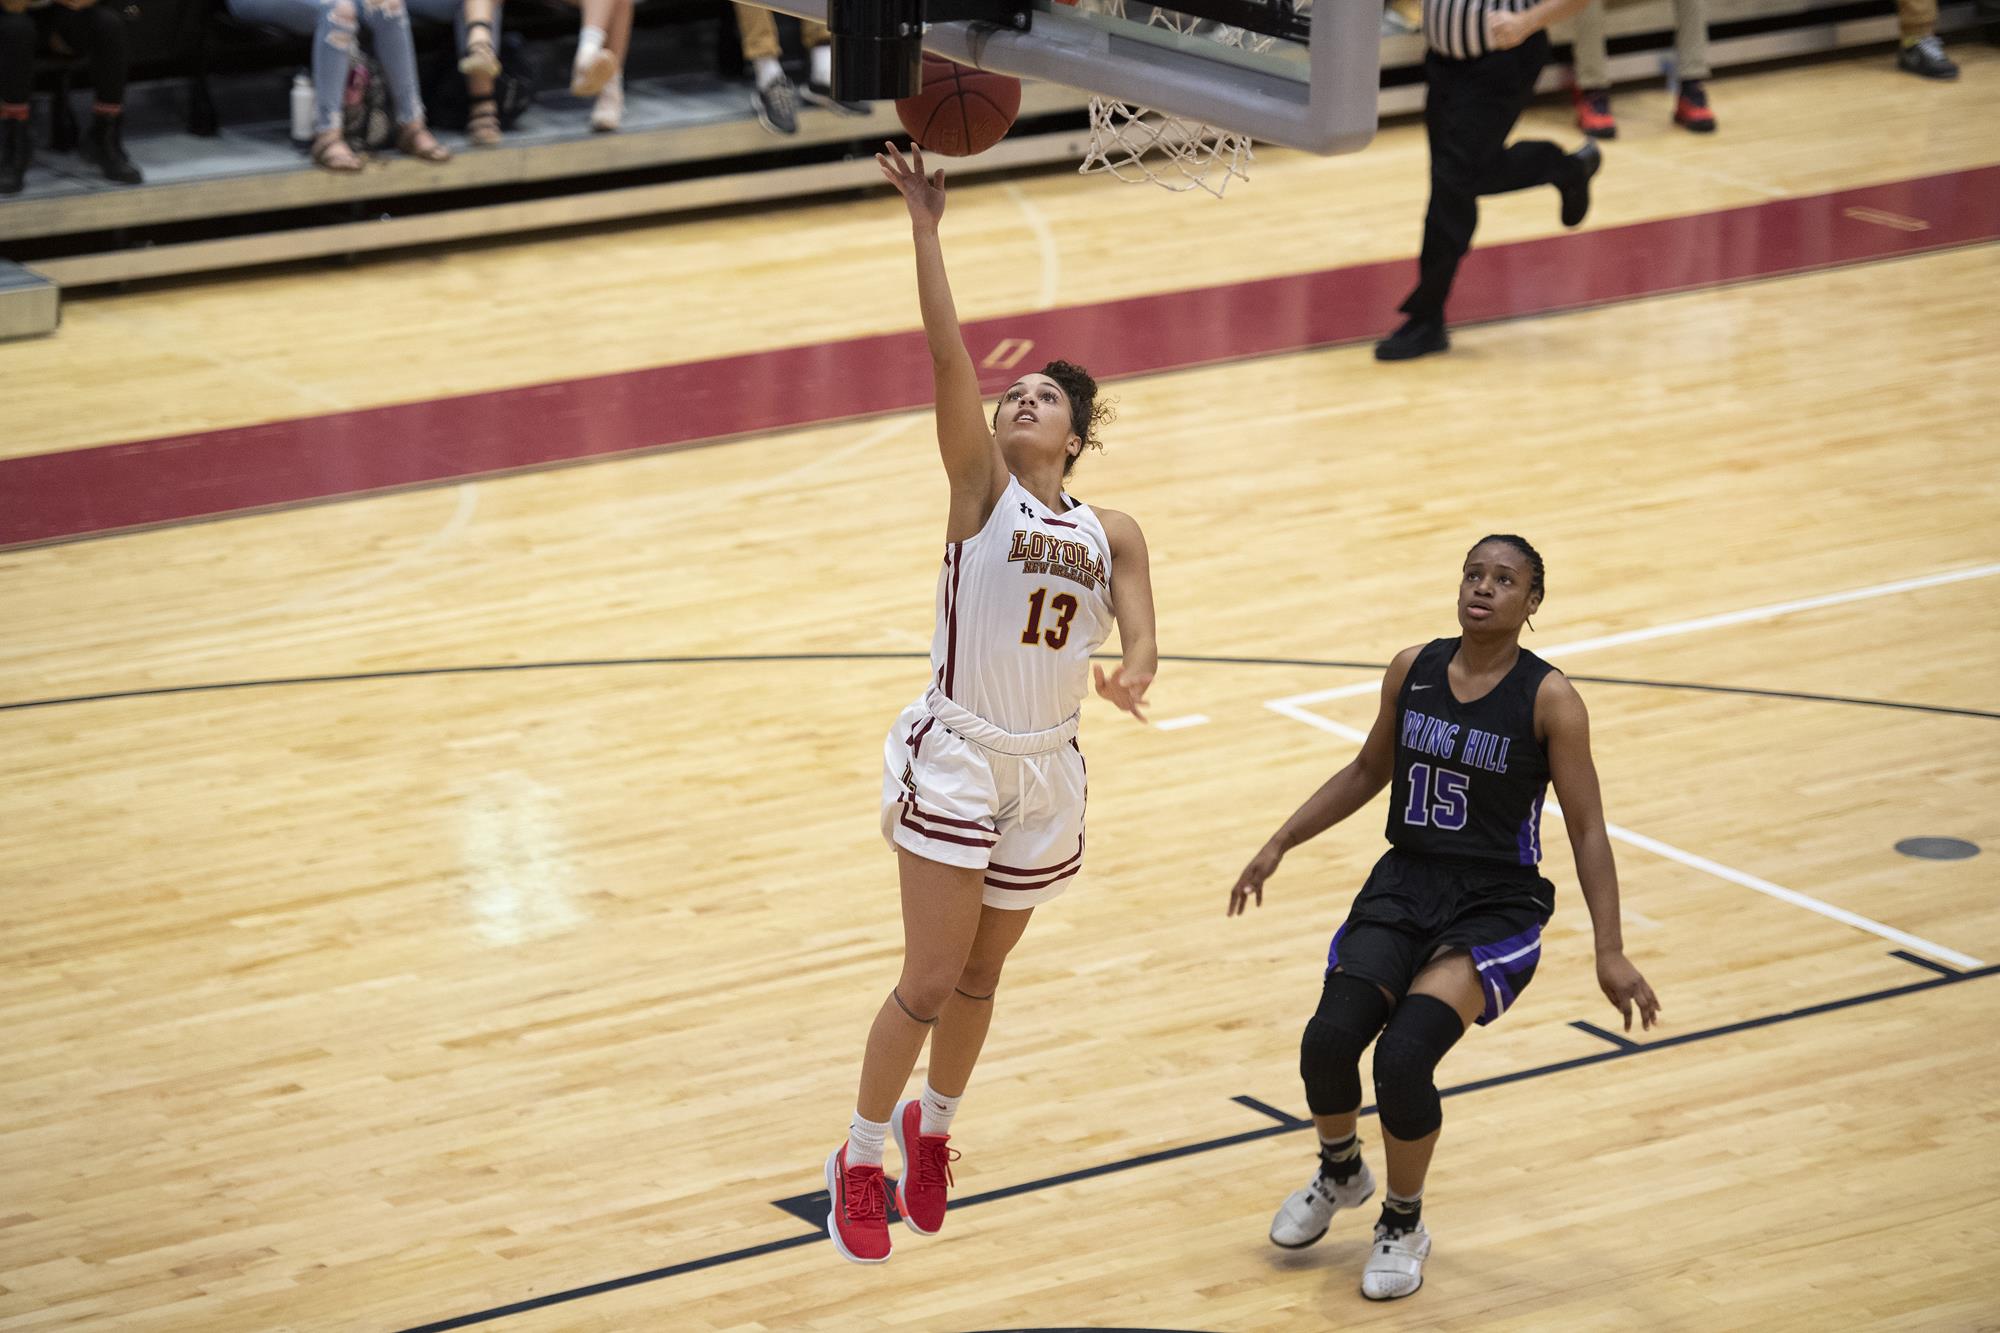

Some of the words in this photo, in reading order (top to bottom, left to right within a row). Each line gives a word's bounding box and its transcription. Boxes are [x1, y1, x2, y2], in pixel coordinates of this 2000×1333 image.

[1008, 530, 1107, 589] LOYOLA
[1022, 560, 1050, 574] NEW
[1021, 586, 1078, 650] 13
[1402, 709, 1460, 759] PRING
[1461, 729, 1511, 774] HILL
[1404, 762, 1470, 831] 15
